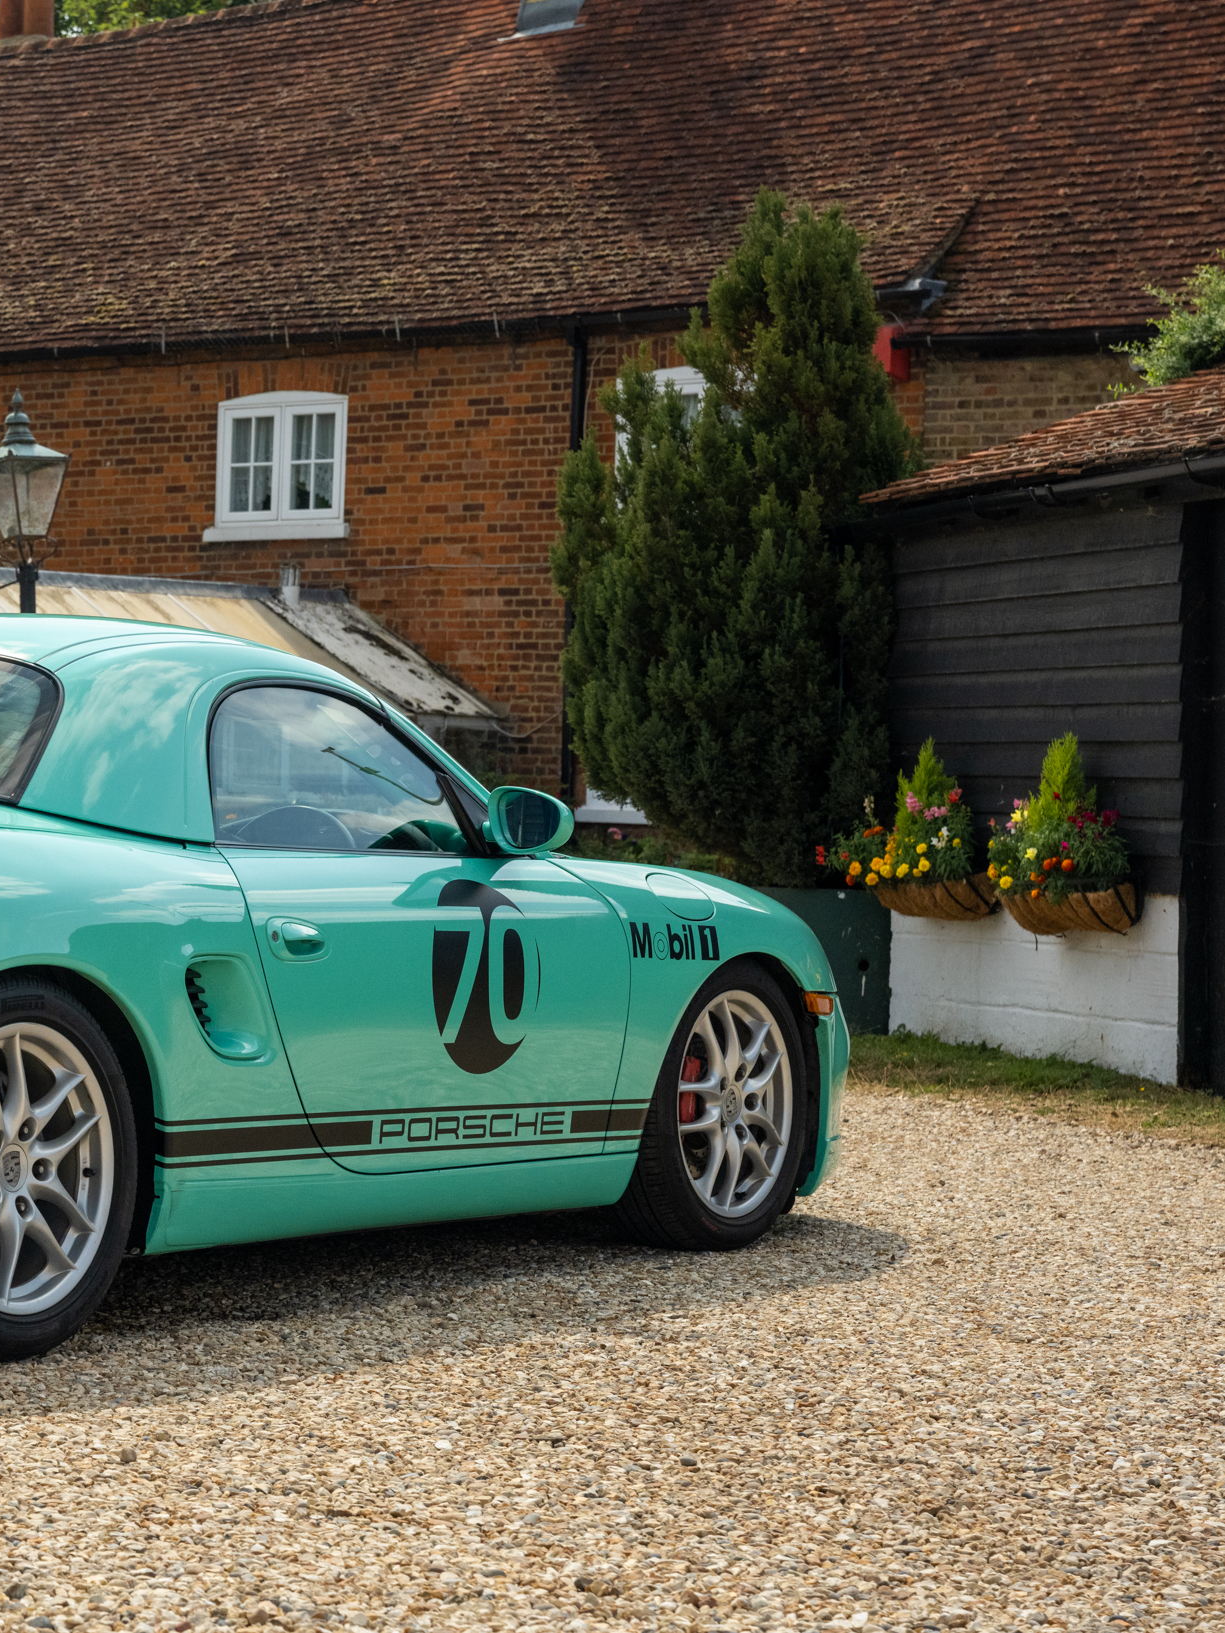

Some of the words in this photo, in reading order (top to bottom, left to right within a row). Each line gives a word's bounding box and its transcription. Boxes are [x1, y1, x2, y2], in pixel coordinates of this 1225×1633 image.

[629, 922, 695, 960] Mobil
[702, 927, 717, 959] 1
[433, 903, 539, 1046] 70
[1, 995, 45, 1012] PIRELLI
[378, 1110, 566, 1144] PORSCHE
